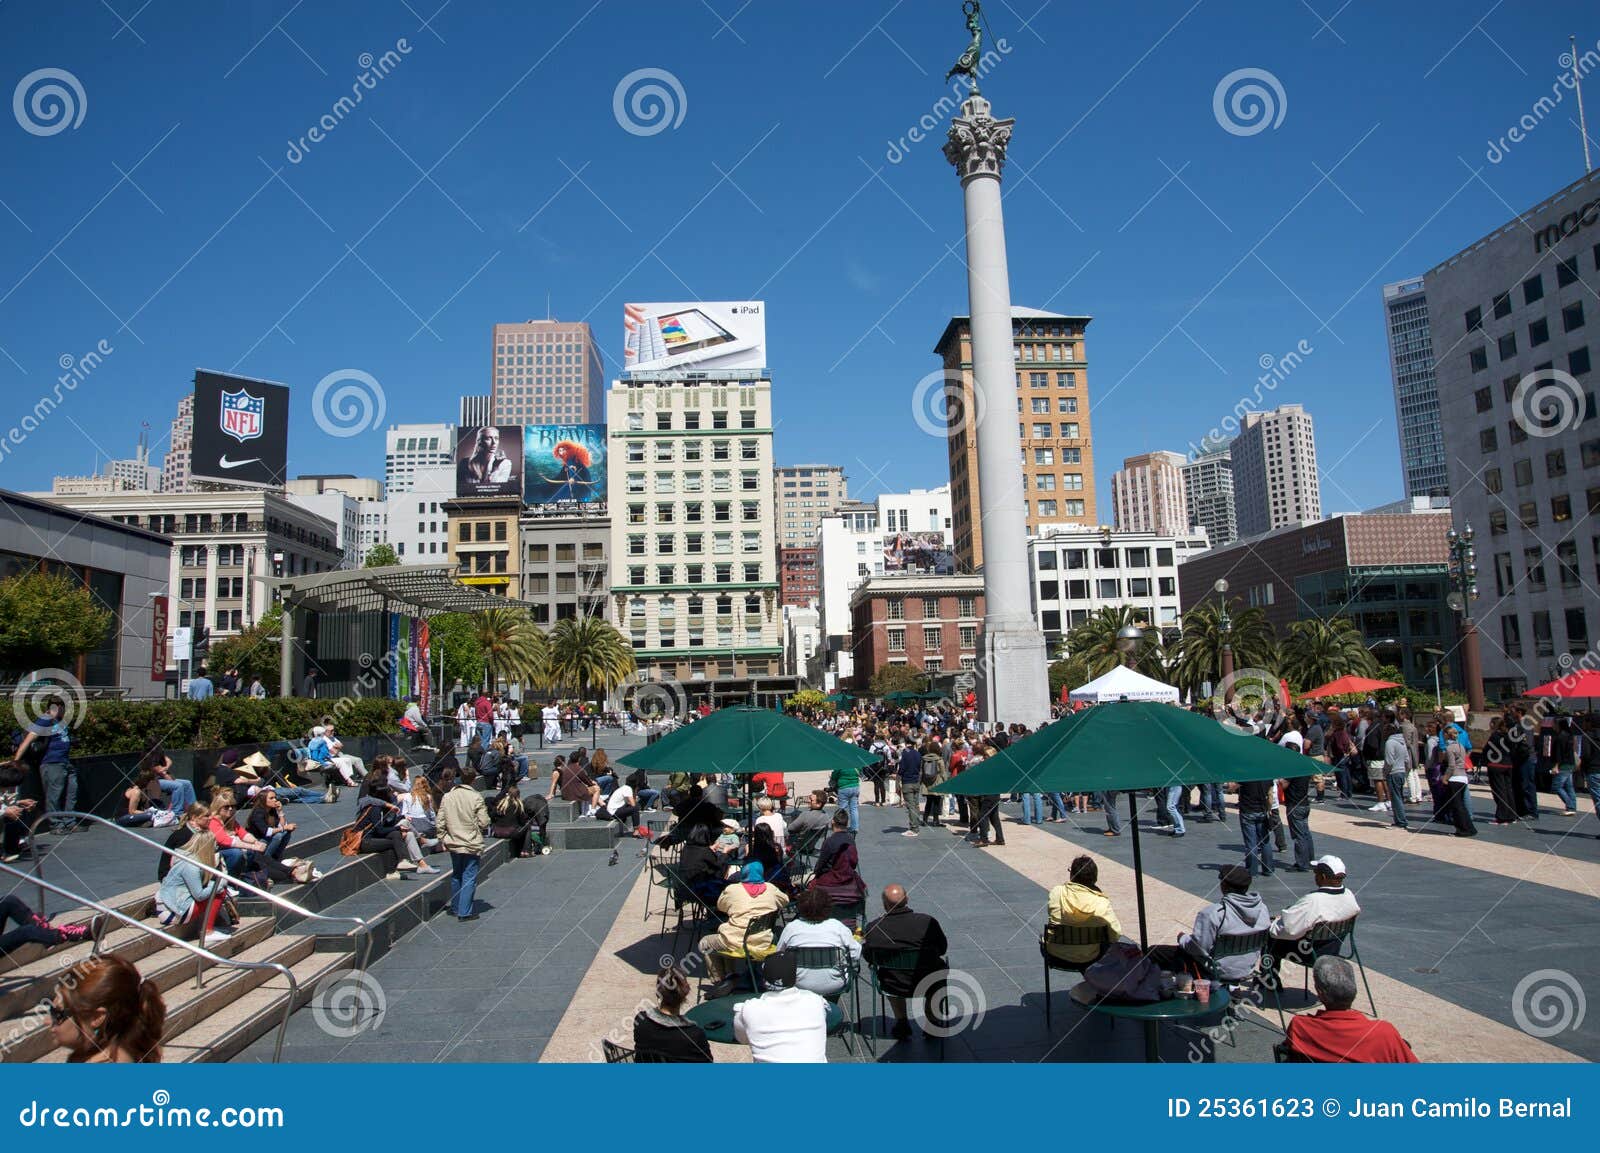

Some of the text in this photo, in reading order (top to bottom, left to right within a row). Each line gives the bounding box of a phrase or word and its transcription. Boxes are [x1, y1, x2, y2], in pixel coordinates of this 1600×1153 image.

[740, 306, 760, 315] iPad
[225, 409, 258, 434] NFL
[538, 429, 595, 445] BRAVE
